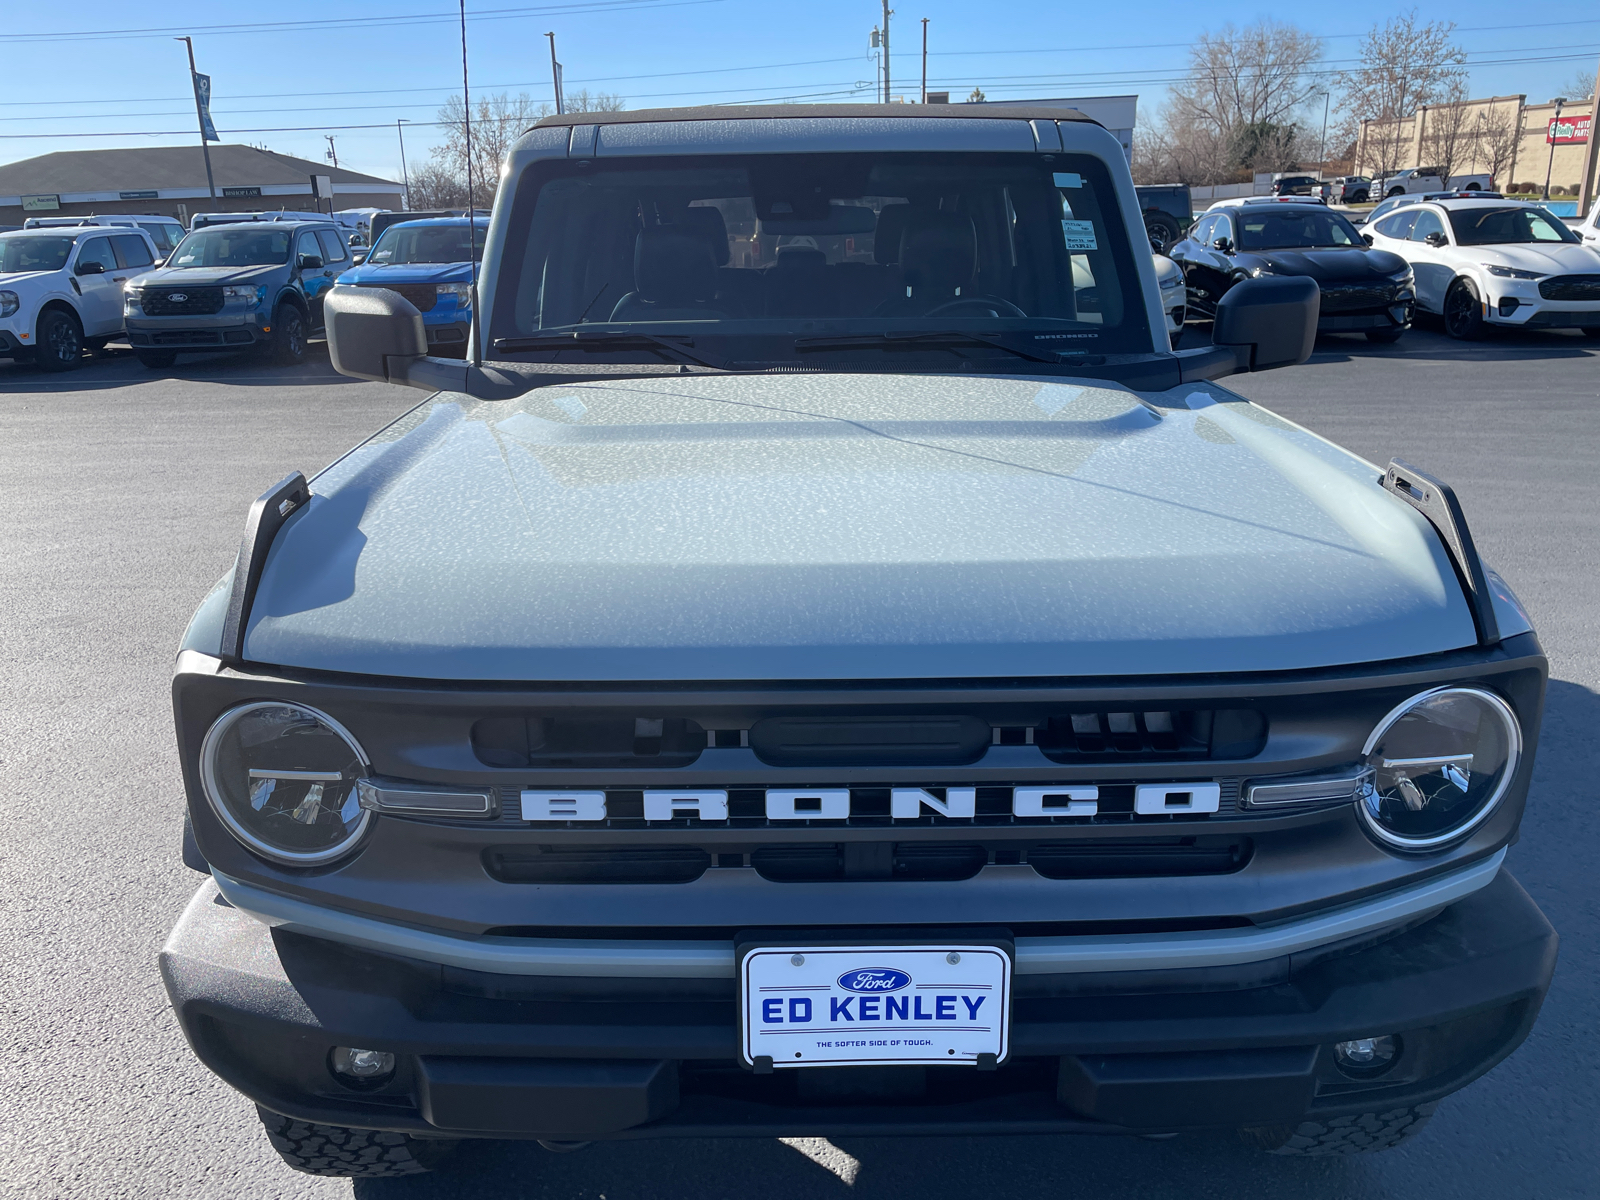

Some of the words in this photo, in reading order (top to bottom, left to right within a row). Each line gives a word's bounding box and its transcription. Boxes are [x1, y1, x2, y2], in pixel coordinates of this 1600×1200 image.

[520, 781, 1221, 821] BRONCO
[852, 972, 895, 991] Ford
[762, 997, 813, 1024] ED
[830, 995, 987, 1022] KENLEY
[835, 1040, 867, 1048] SOFTER
[869, 1039, 888, 1047] SIDE
